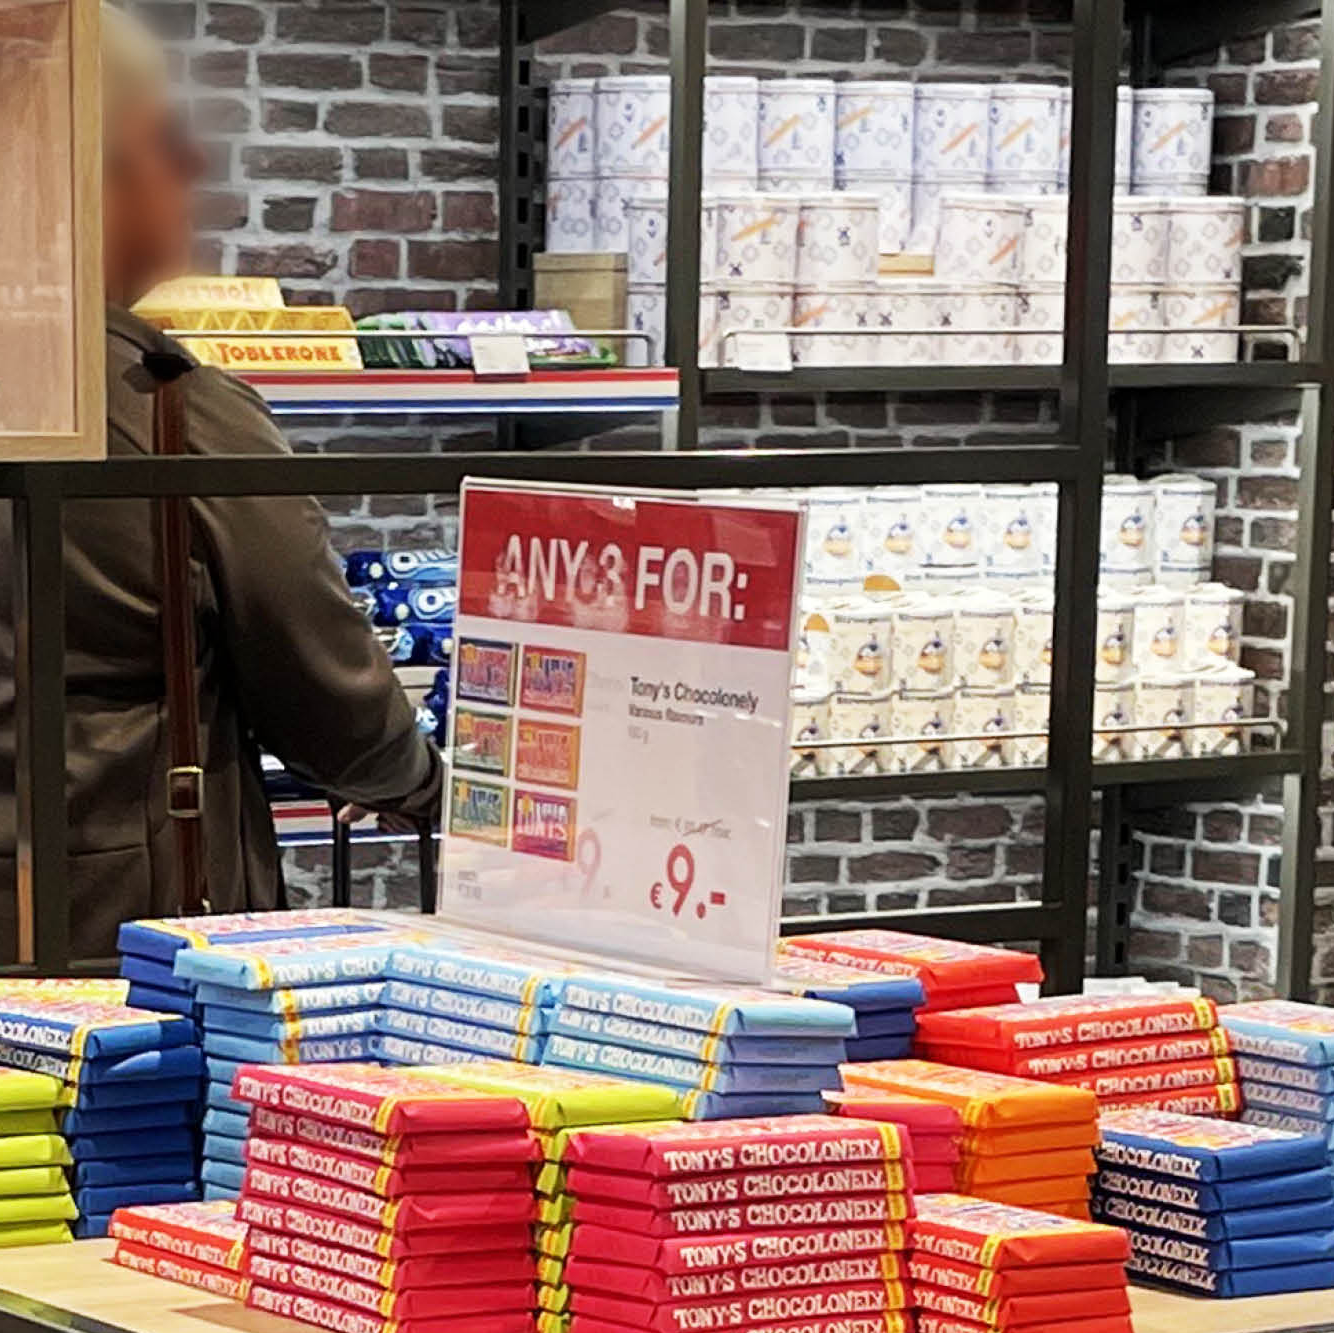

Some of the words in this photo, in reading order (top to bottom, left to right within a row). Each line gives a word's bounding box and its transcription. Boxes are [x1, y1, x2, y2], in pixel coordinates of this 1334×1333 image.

[497, 533, 589, 600] ANY
[634, 545, 749, 621] FOR:
[630, 676, 671, 702] Tony's
[674, 682, 759, 715] Chocolonely
[665, 1146, 734, 1172] TONY'S
[665, 1178, 738, 1204] TONY'S
[671, 1207, 740, 1232] TONY'S
[681, 1239, 747, 1268] TONY'S
[669, 1270, 737, 1297] TONY'S
[673, 1302, 742, 1329] TONY'S
